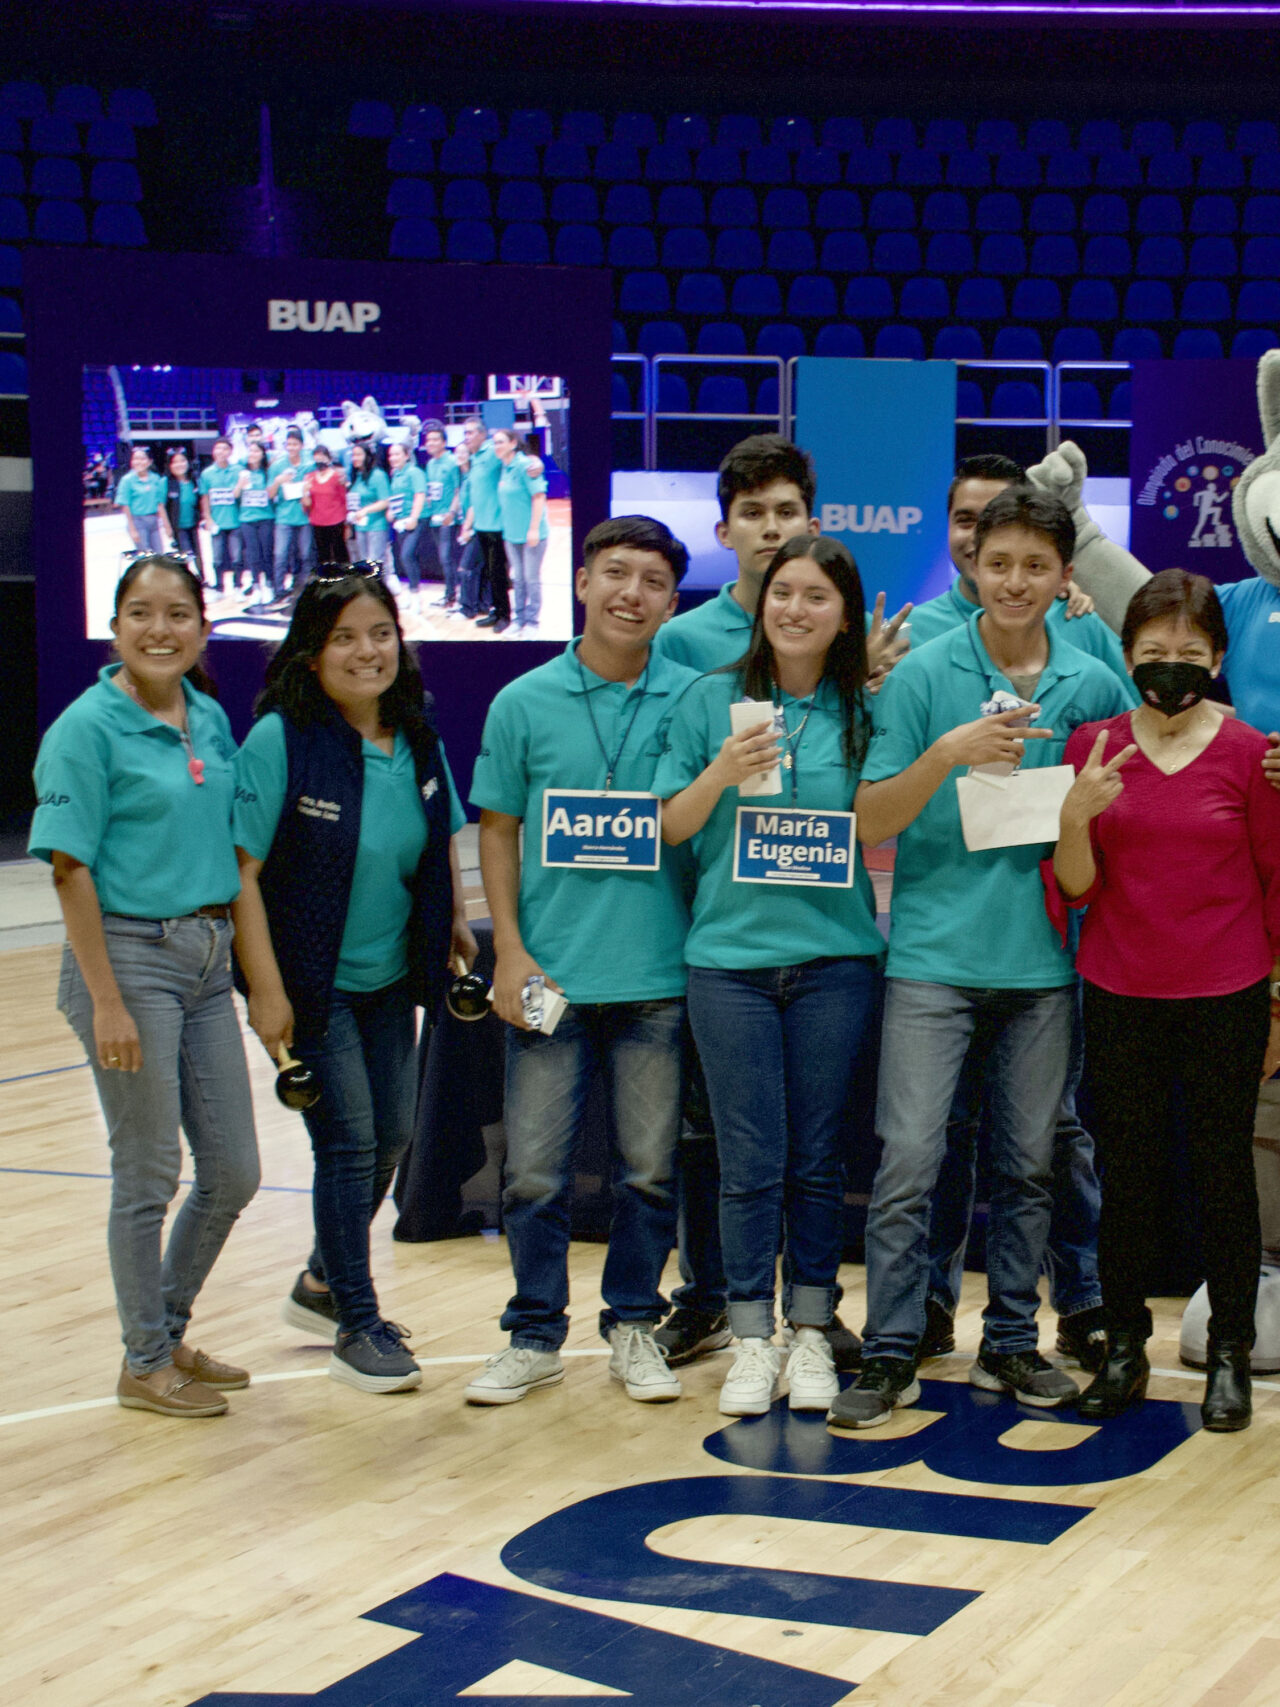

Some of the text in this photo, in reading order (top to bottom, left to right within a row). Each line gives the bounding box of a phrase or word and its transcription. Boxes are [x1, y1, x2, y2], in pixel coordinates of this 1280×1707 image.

[1174, 439, 1196, 461] del
[546, 807, 656, 839] Aarón
[755, 814, 830, 838] María
[747, 838, 848, 867] Eugenia
